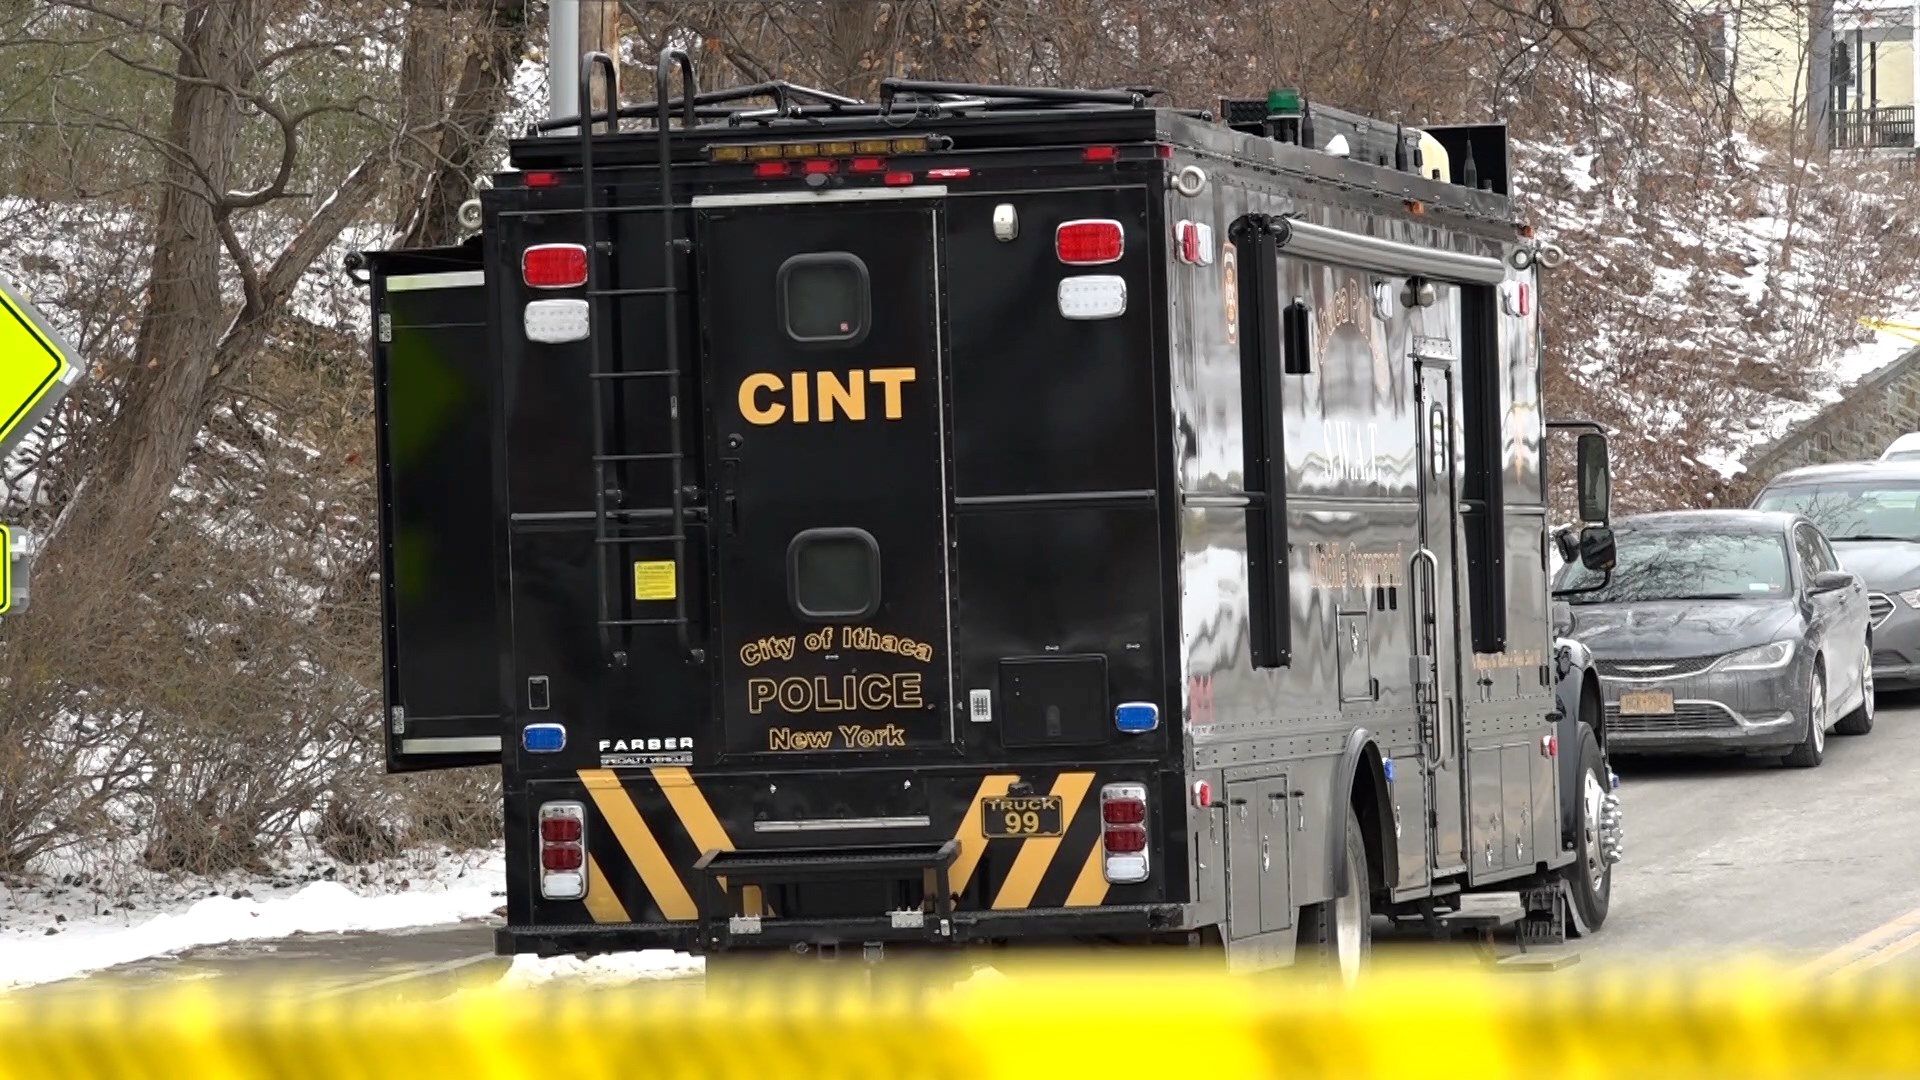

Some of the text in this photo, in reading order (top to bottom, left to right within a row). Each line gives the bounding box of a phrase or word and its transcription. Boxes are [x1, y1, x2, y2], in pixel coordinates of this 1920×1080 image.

[738, 367, 916, 425] CINT
[740, 627, 933, 666] City of Ithaca
[748, 673, 923, 714] POLICE
[599, 737, 693, 752] FARBER
[769, 724, 906, 750] New York
[988, 798, 1056, 811] TRUCK
[1004, 811, 1039, 834] 99
